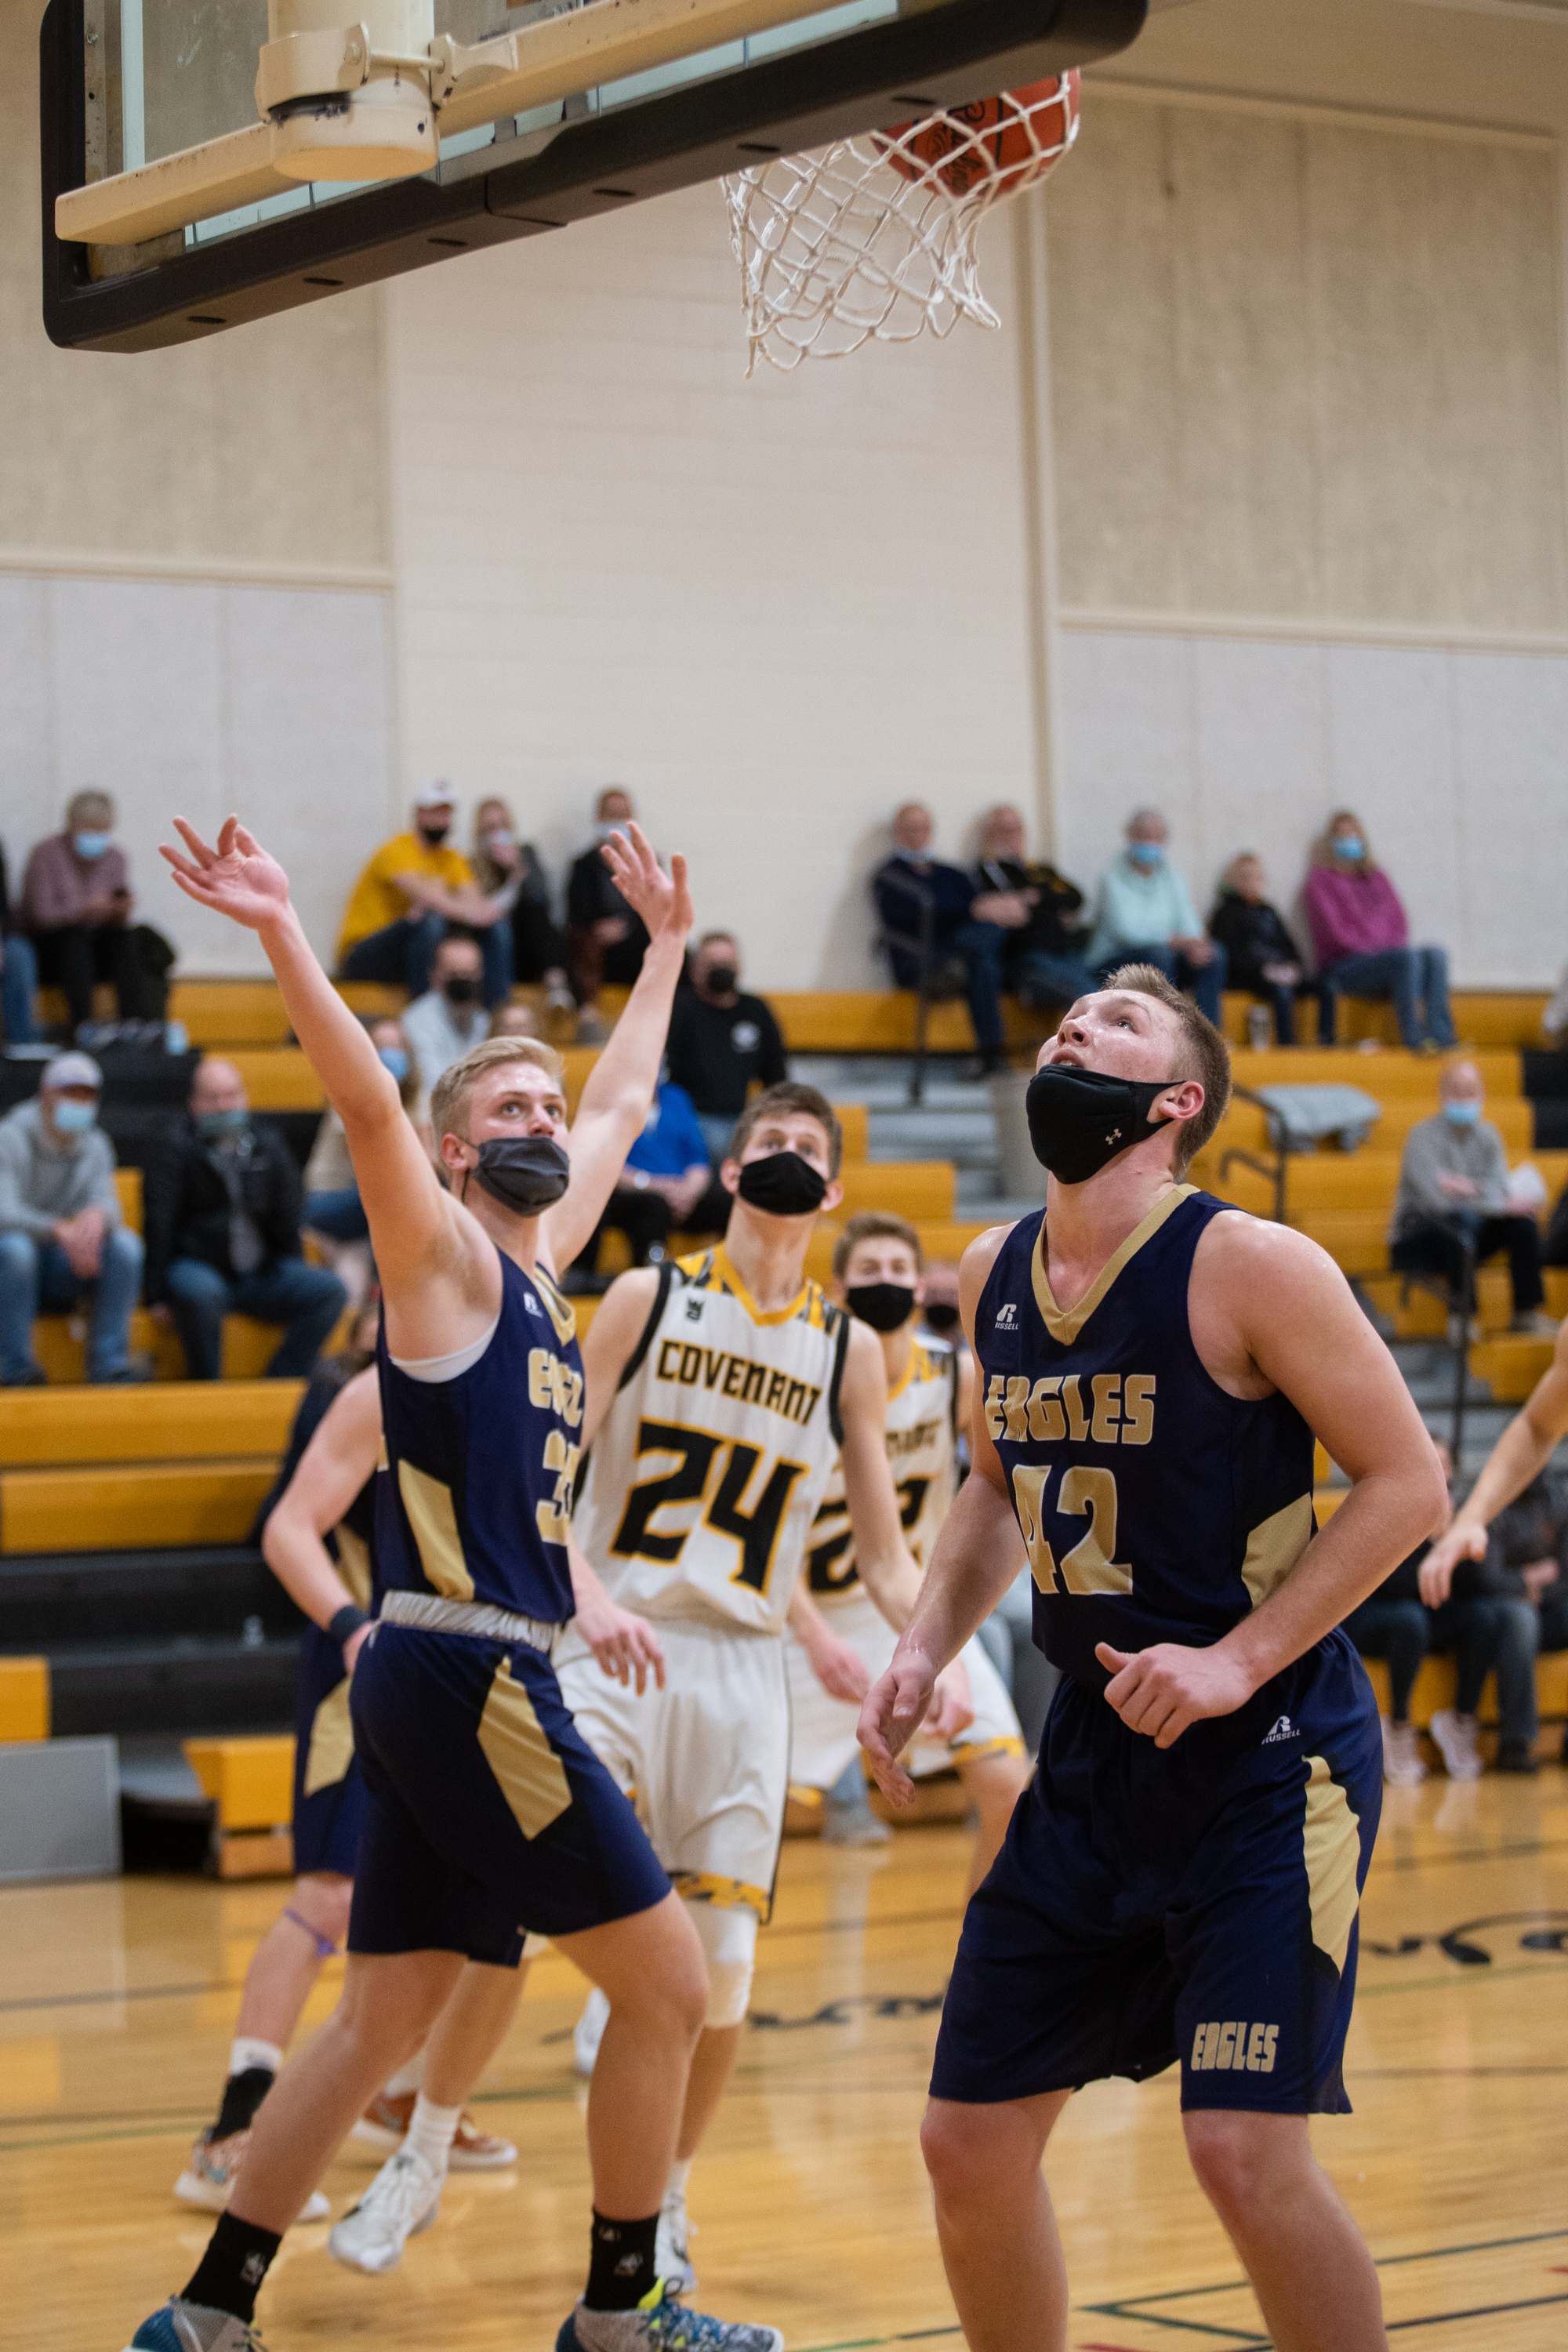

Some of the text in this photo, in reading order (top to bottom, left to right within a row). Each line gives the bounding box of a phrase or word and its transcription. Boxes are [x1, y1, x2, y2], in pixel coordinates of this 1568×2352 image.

[656, 1338, 822, 1427] COVENANT
[985, 1374, 1156, 1445] EAGLES
[607, 1415, 811, 1598] 24
[1012, 1464, 1134, 1595] 42
[1191, 2022, 1279, 2073] EAGLES
